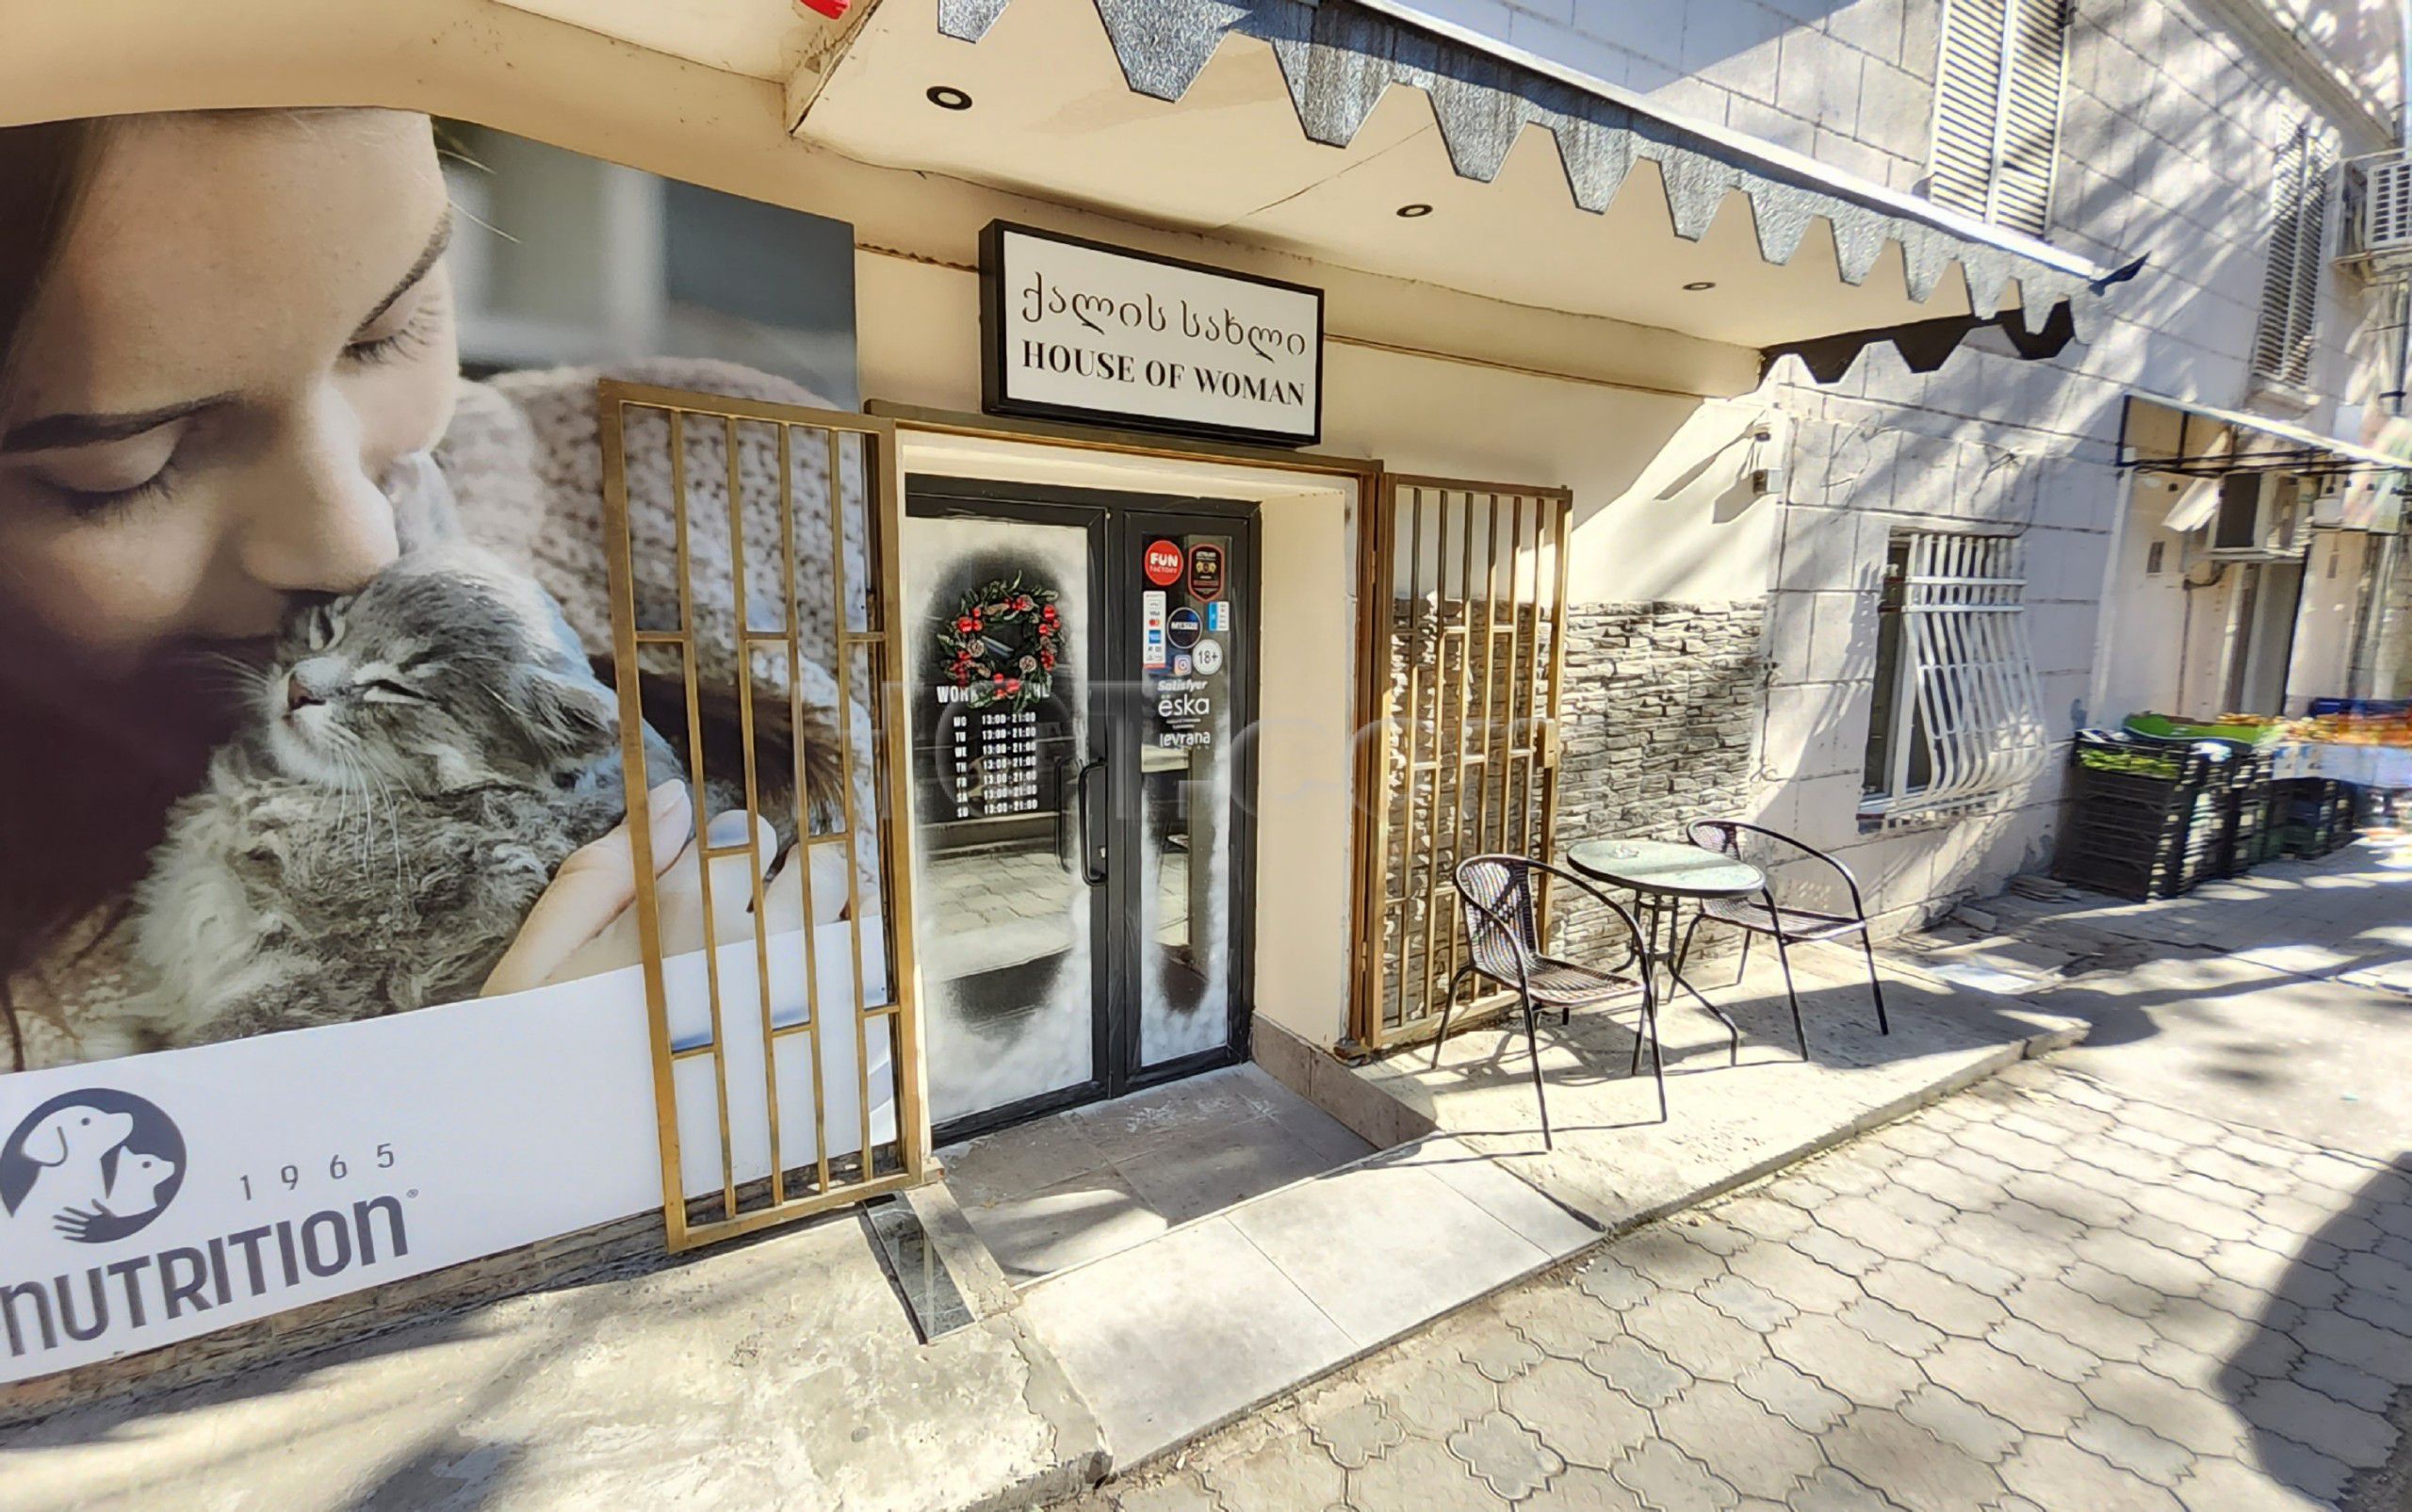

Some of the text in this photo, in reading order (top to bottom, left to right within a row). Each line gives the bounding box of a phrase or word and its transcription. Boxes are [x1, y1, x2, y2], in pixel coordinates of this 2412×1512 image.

[1021, 270, 1306, 364] ქალის სახლი
[1020, 339, 1306, 407] HOUSE OF WOMAN
[1149, 552, 1179, 567] FUN
[1198, 650, 1219, 664] 18+
[1158, 693, 1210, 717] ëska
[1159, 731, 1211, 748] levrana
